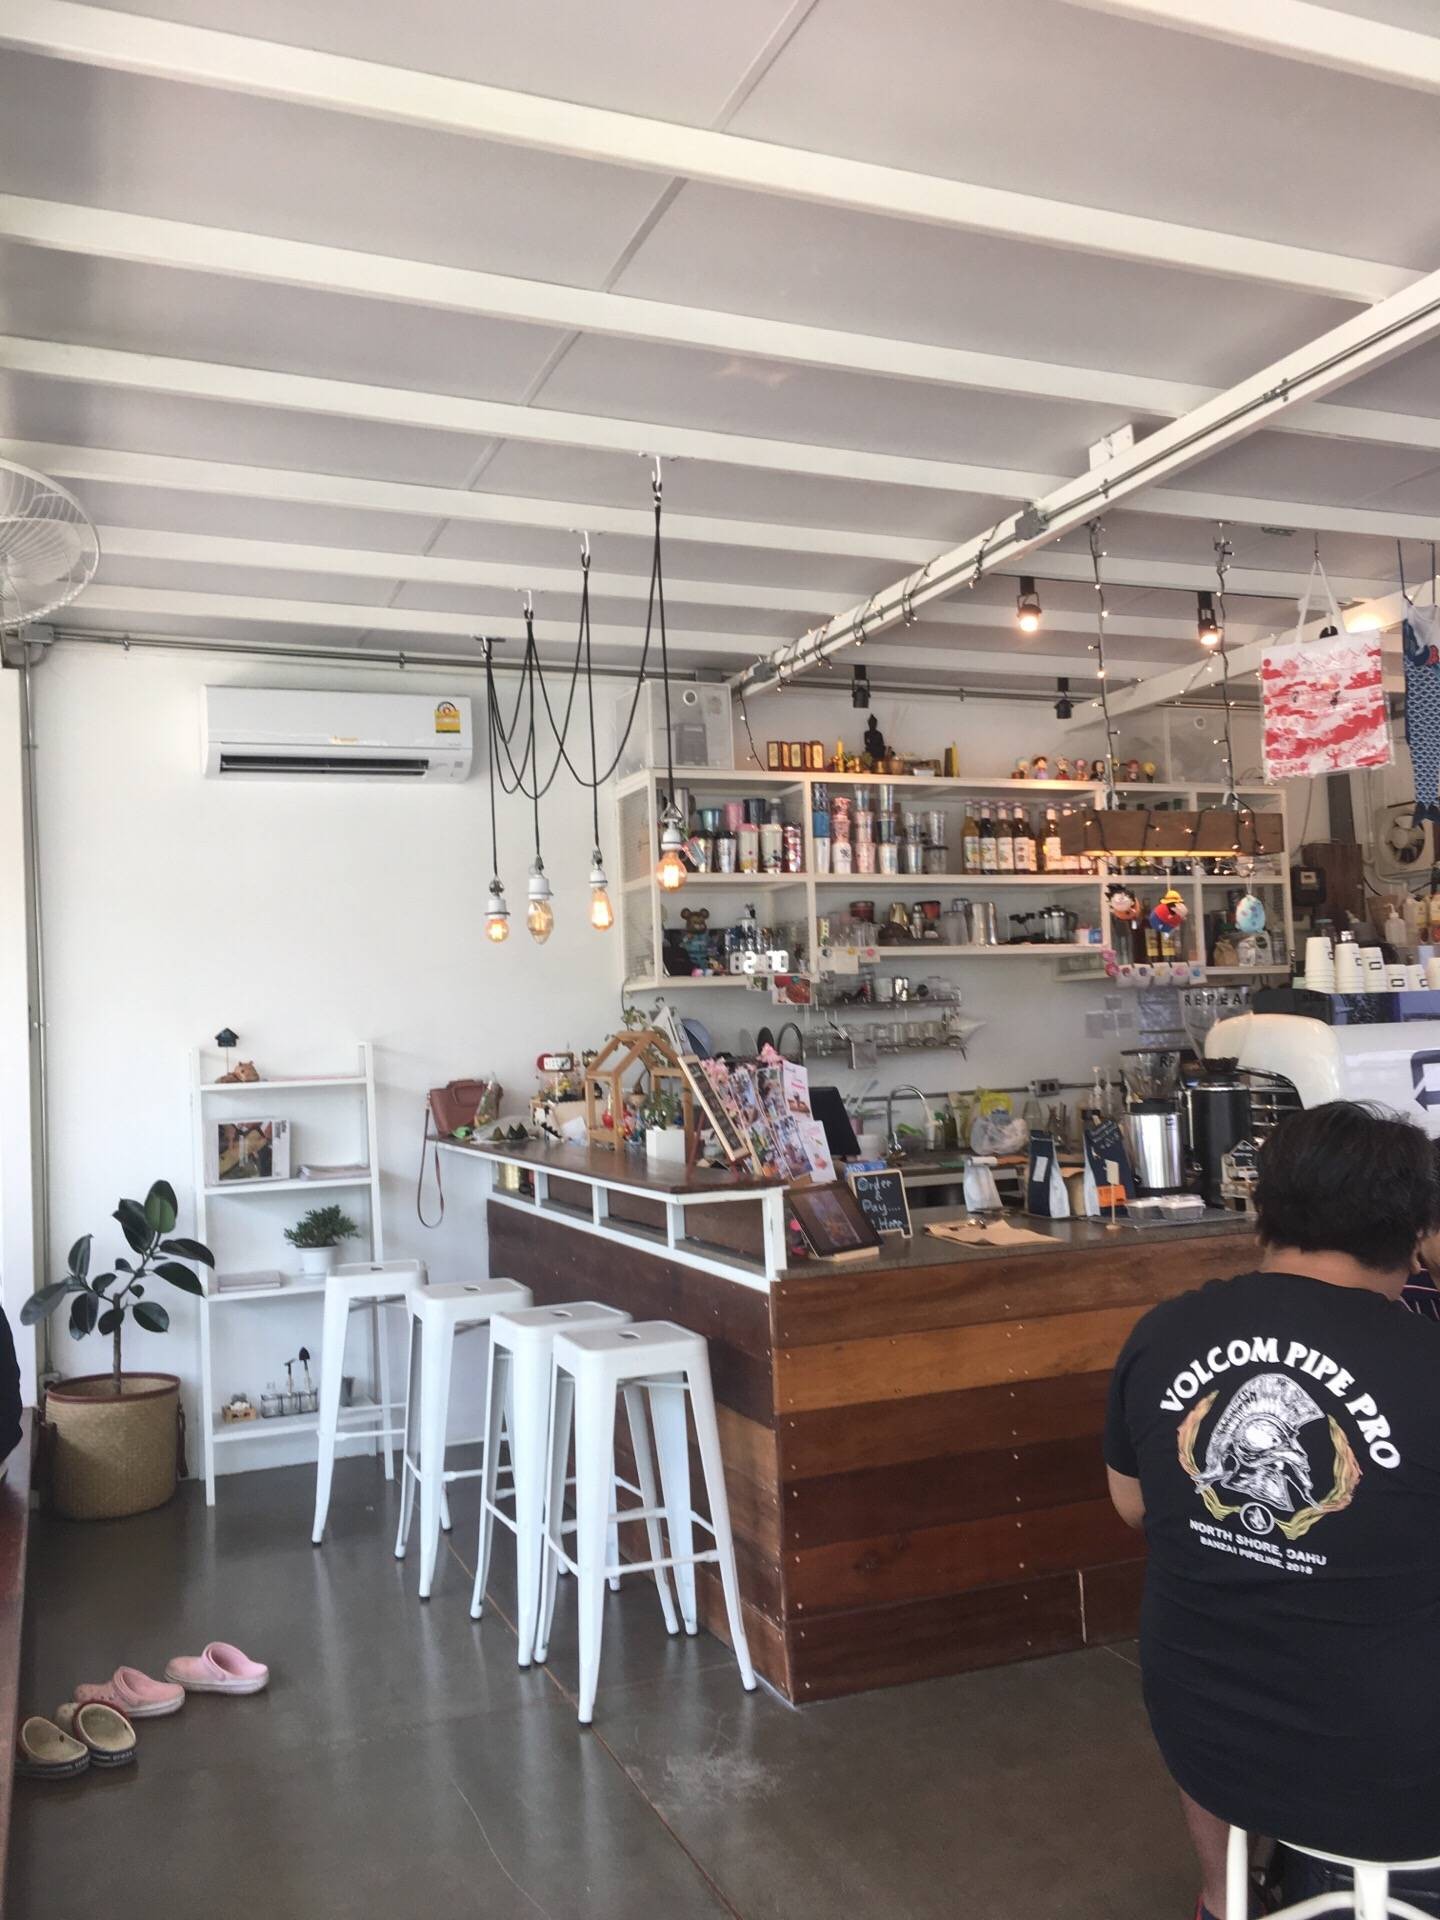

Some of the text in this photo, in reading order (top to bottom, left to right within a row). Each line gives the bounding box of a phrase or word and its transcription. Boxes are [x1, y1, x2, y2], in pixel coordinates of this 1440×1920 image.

[857, 1176, 893, 1192] Order
[1160, 1336, 1401, 1469] VOLCOM PIPE PRO
[1190, 1519, 1233, 1542] NORTH
[1235, 1533, 1284, 1558] SHORE,
[1199, 1535, 1238, 1554] BANZAI
